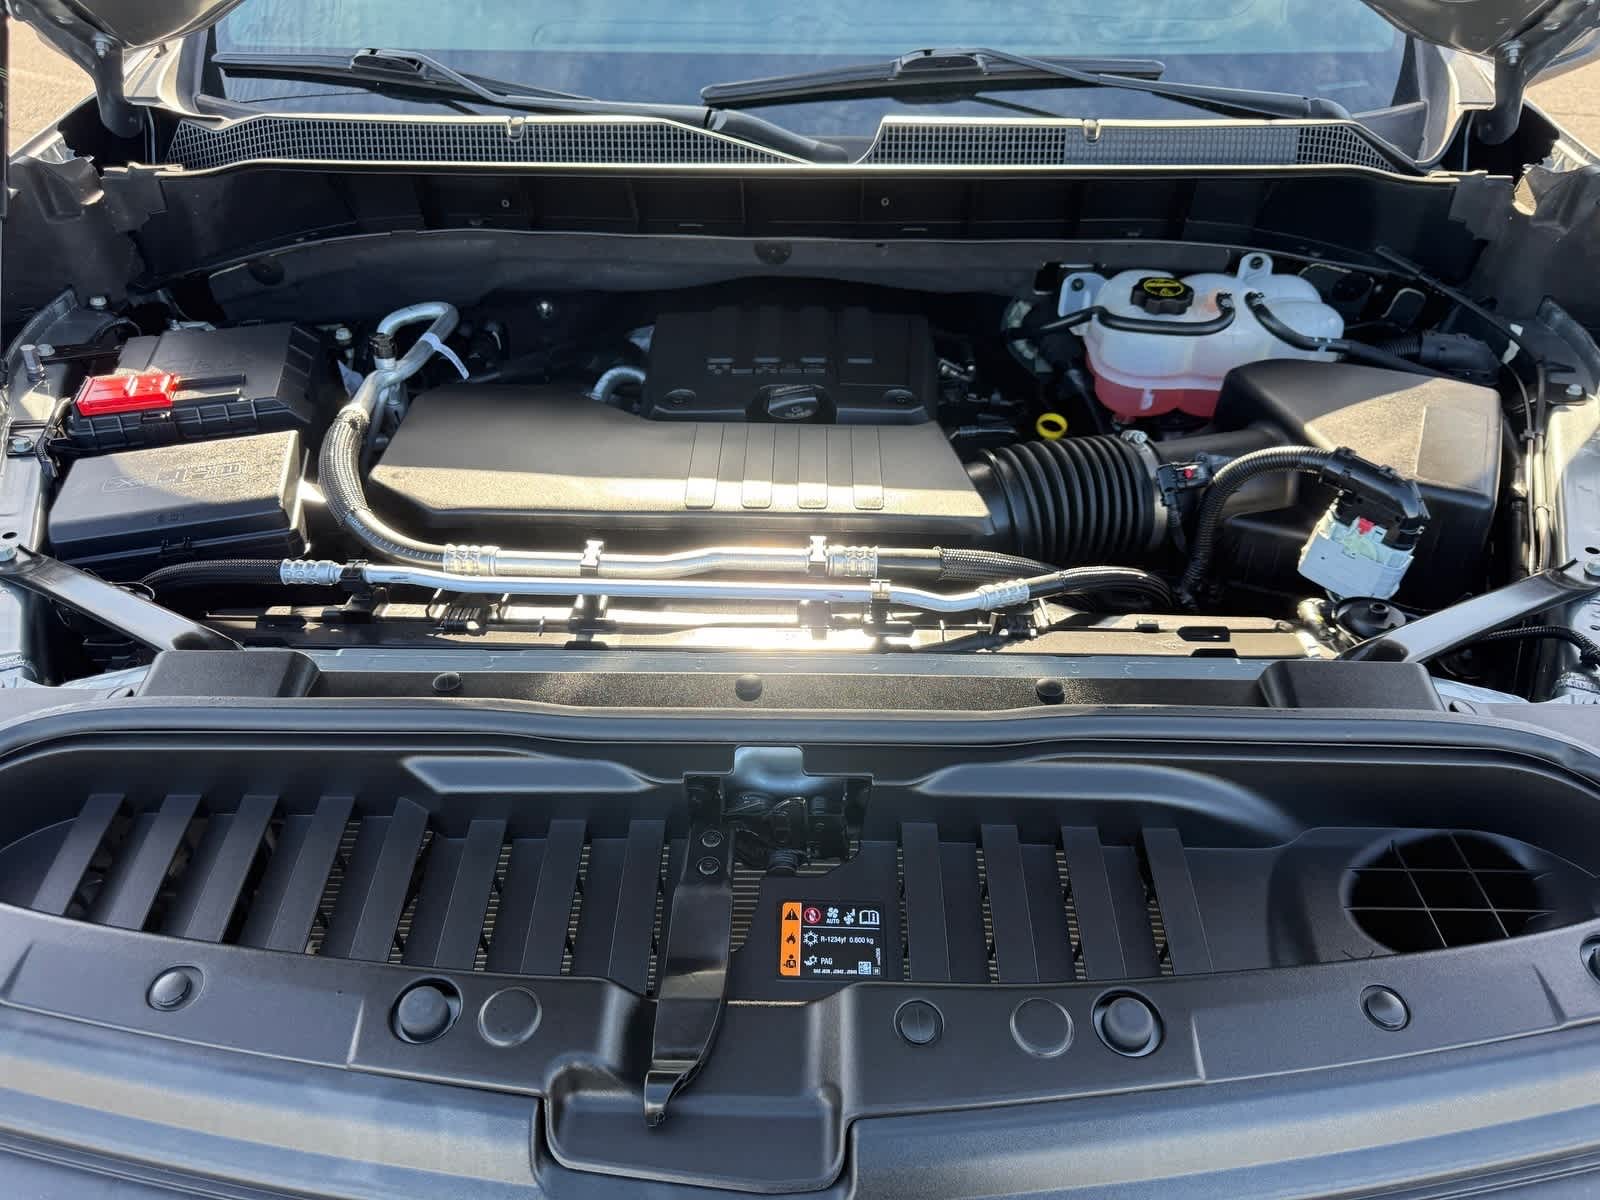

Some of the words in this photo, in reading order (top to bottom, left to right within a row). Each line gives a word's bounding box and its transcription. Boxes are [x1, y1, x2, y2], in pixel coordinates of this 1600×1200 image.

[820, 936, 847, 945] R-1234yf
[866, 937, 875, 945] kg
[820, 957, 833, 965] PAG
